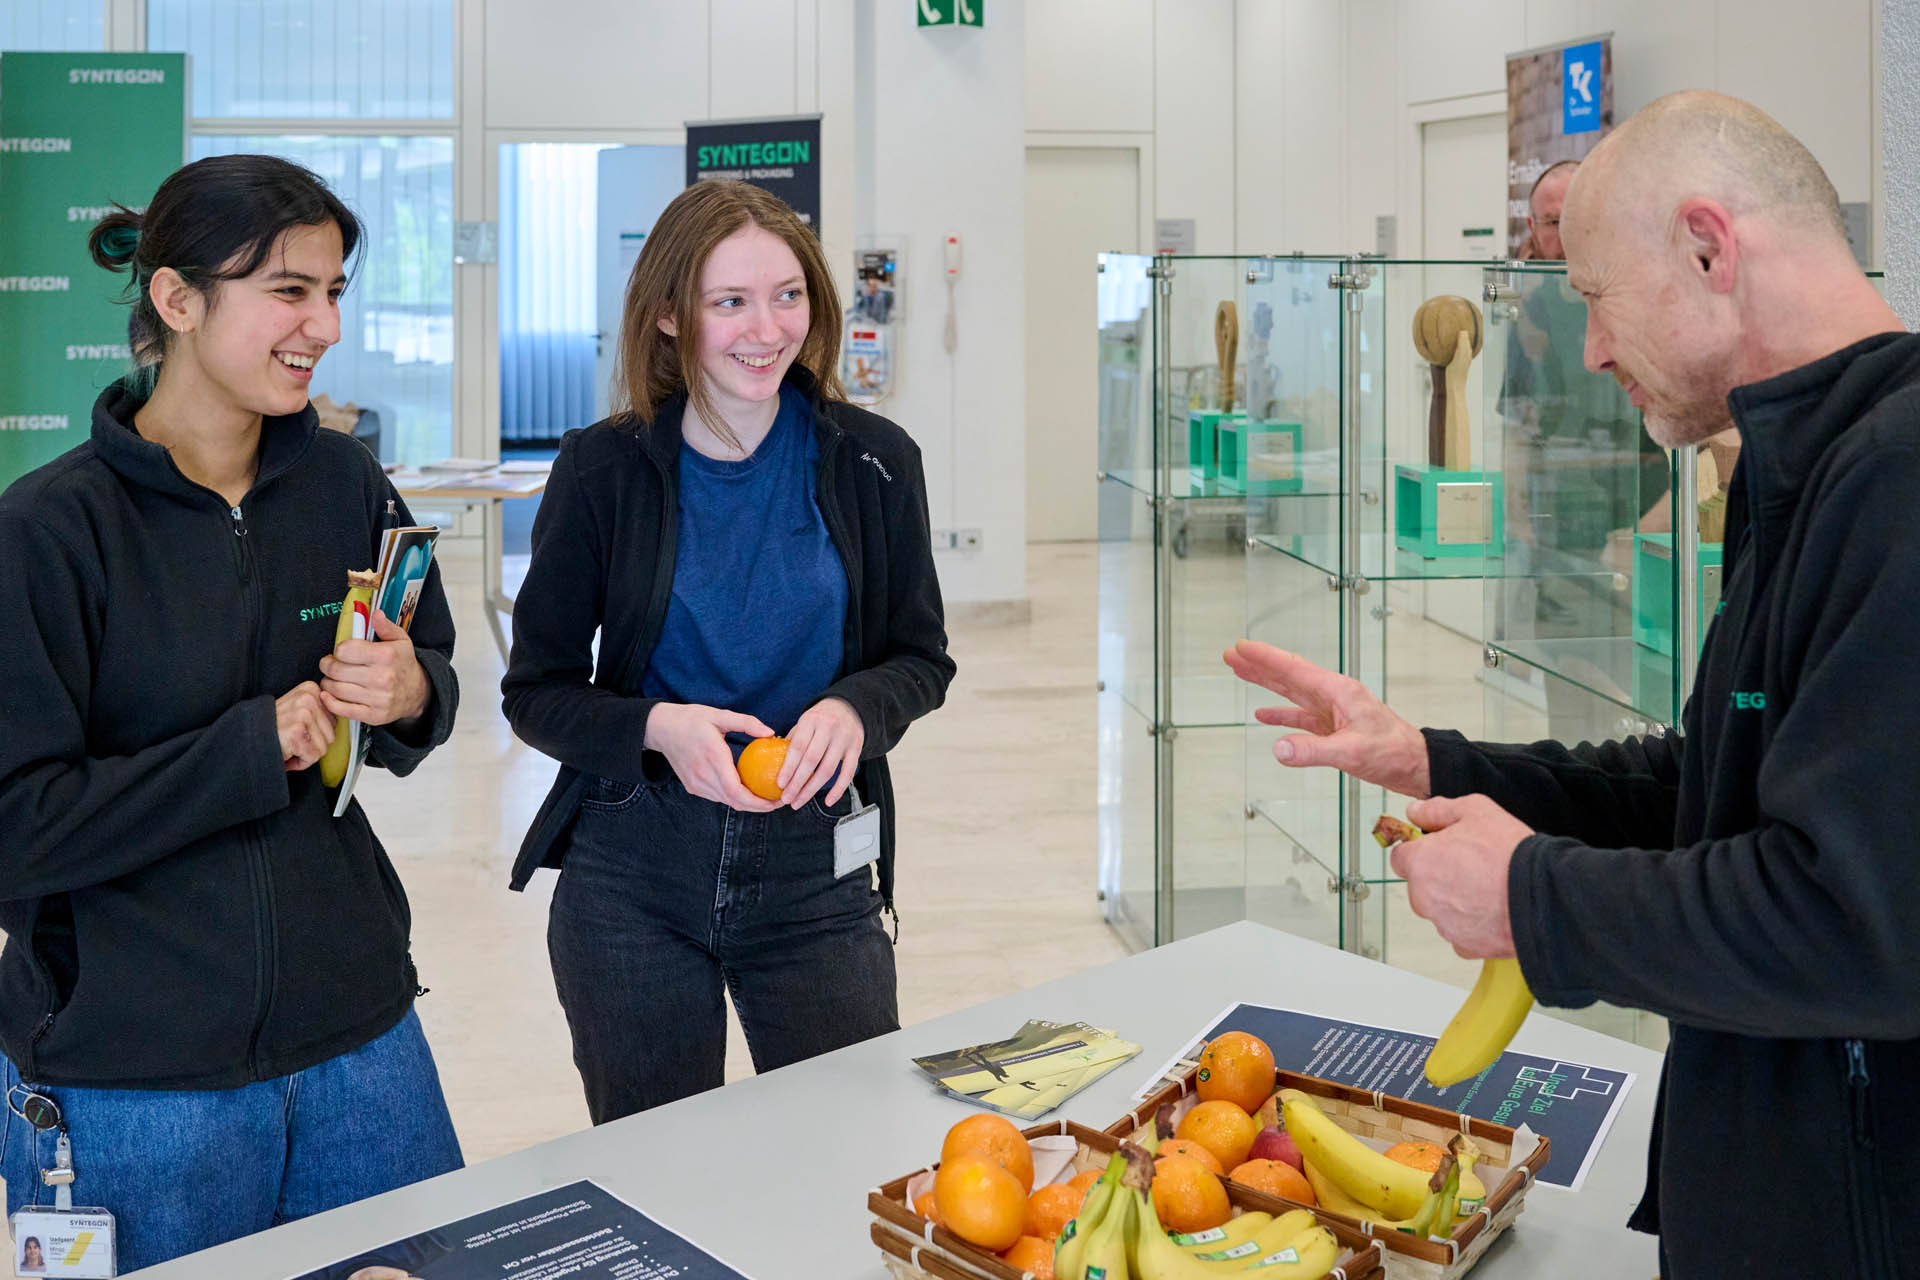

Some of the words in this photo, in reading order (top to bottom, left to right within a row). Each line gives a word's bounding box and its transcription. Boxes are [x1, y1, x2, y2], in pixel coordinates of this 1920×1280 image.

[69, 69, 164, 84] SYNTEGON
[1569, 61, 1593, 103] TK
[697, 140, 810, 168] SYNTEGON
[1507, 1079, 1535, 1099] Eure
[1541, 1073, 1569, 1099] Unser
[1527, 1097, 1553, 1116] Ziel
[595, 1244, 639, 1262] Beratung
[502, 1261, 520, 1269] Ort
[609, 1259, 638, 1272] Drogen
[664, 1270, 679, 1278] Du
